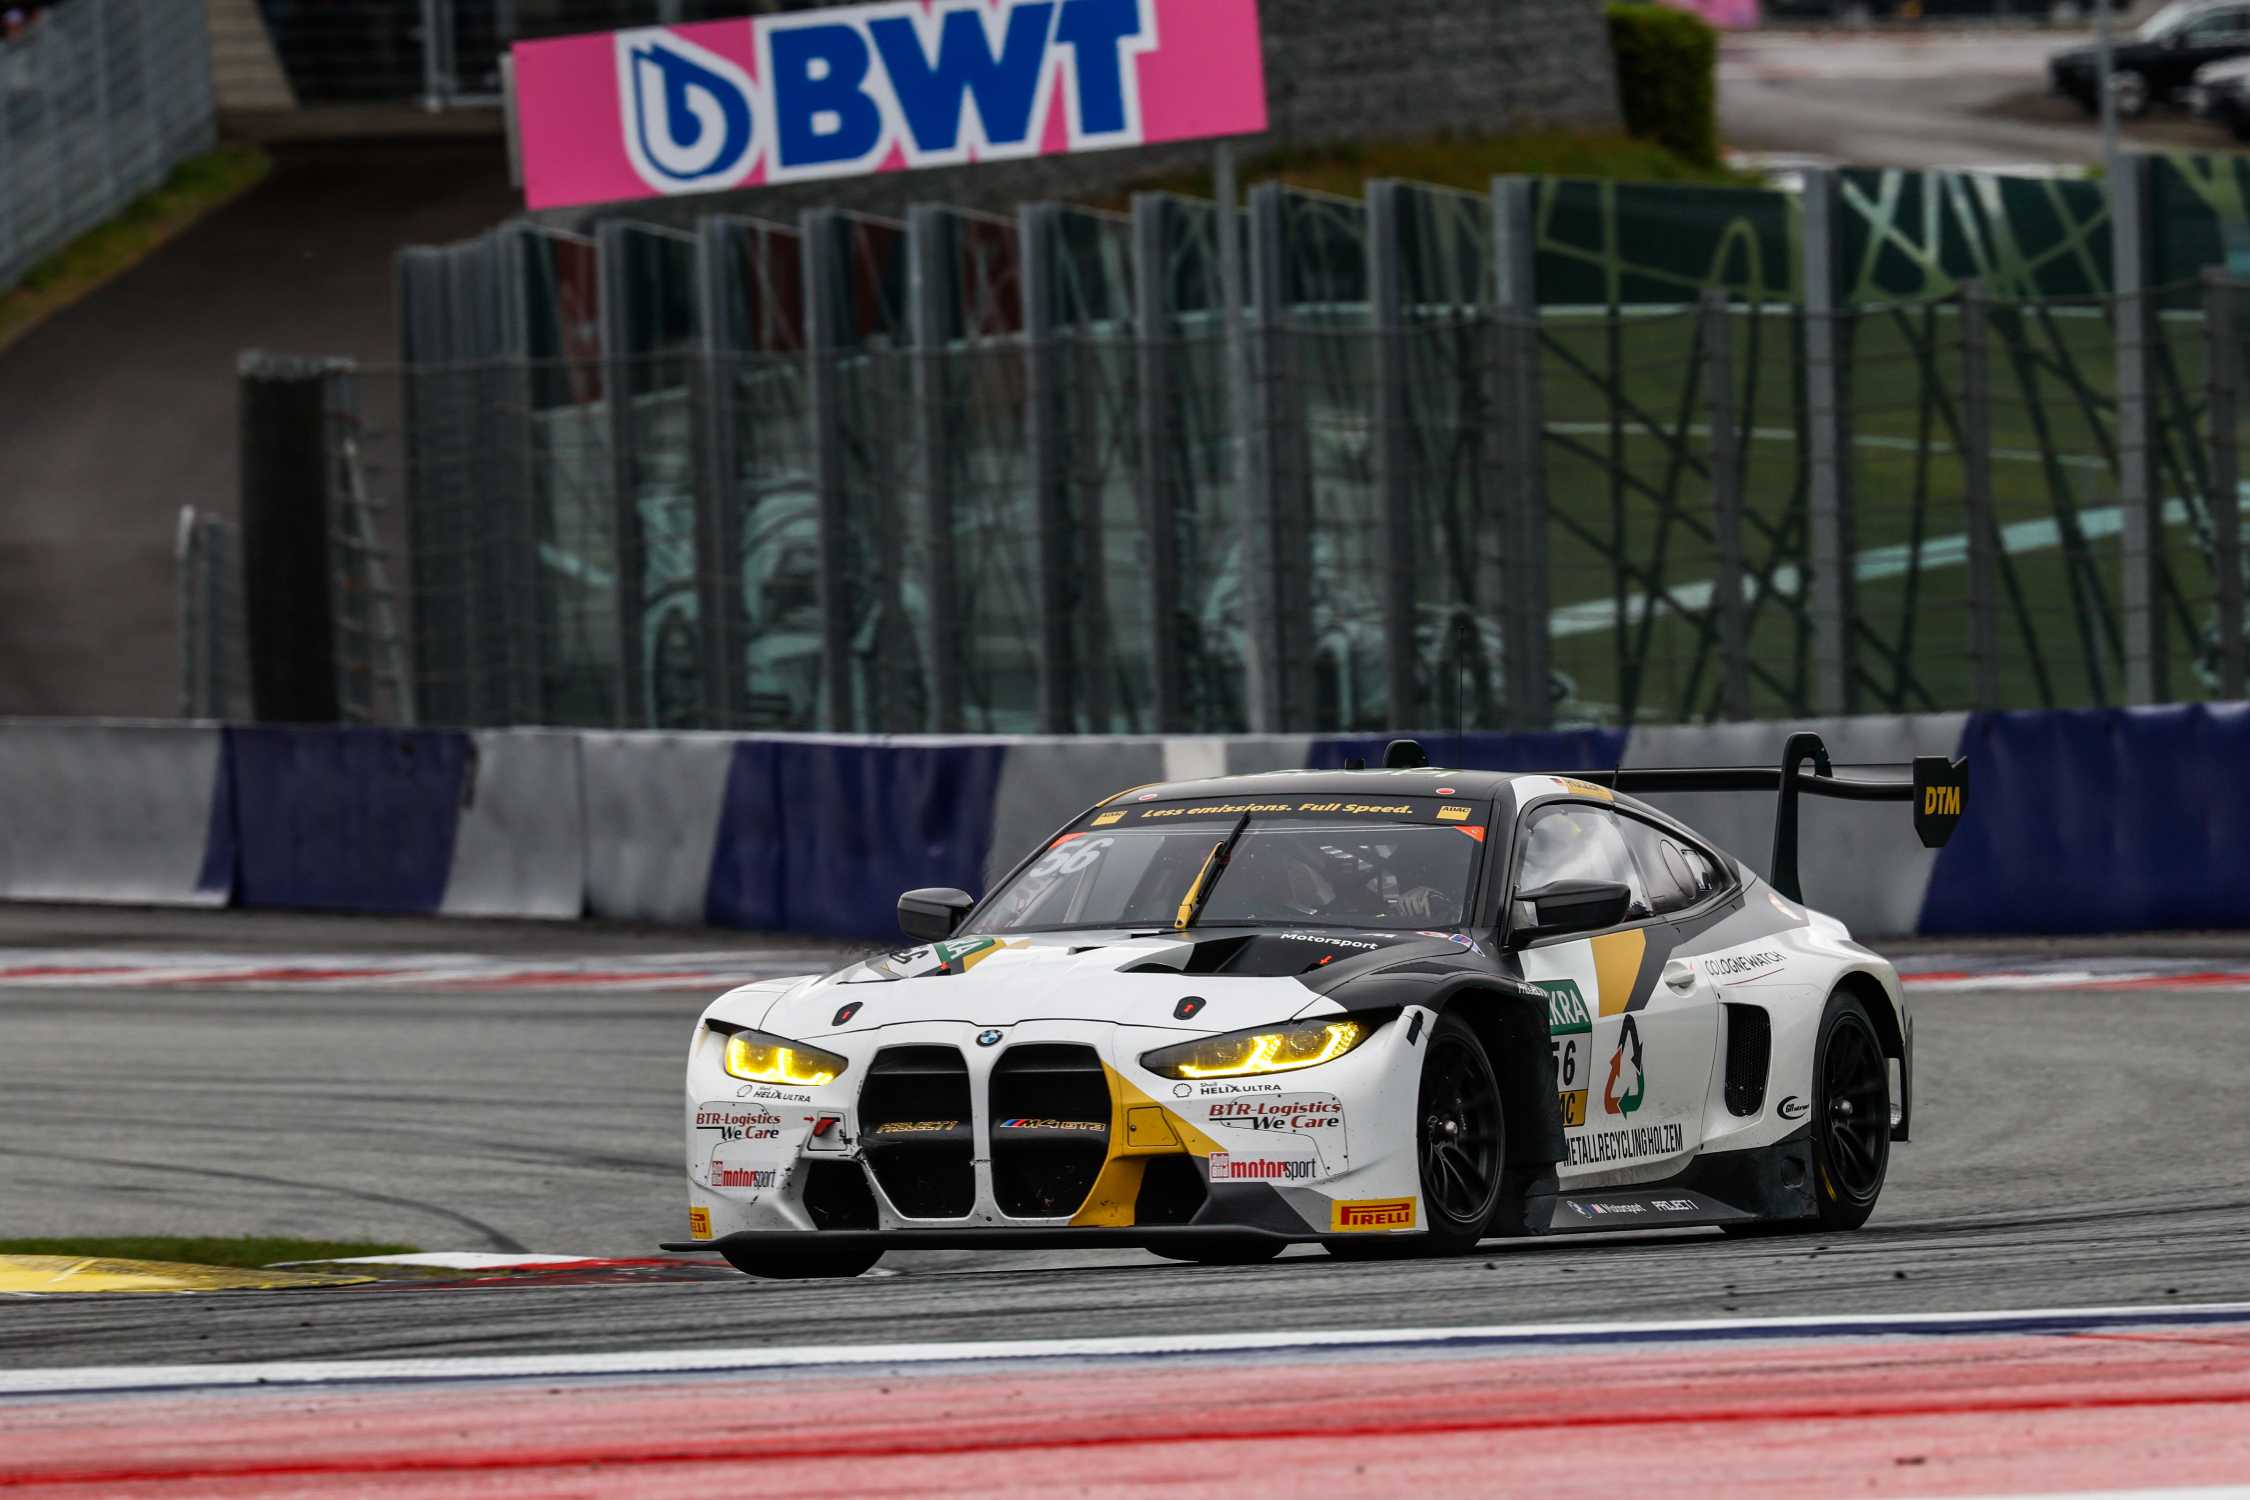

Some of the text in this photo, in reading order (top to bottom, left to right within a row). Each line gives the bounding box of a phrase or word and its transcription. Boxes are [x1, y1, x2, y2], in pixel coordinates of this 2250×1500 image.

[768, 0, 1141, 168] BWT
[1924, 786, 1960, 815] DTM
[1141, 803, 1413, 818] Less emissions. Full Speed.
[1030, 838, 1115, 877] 56
[1280, 932, 1379, 950] Motorsport
[1704, 950, 1787, 976] COLOGNEWATCH
[1549, 989, 1589, 1026] KRA
[753, 1090, 811, 1103] HELIX ULTRA
[1200, 1084, 1240, 1095] HELIX
[1208, 1101, 1341, 1116] BTR-Logistics
[696, 1112, 780, 1126] BTR-Logistics
[1253, 1115, 1339, 1130] We Care
[722, 1126, 779, 1140] We Care
[723, 1168, 775, 1189] motorsport
[1230, 1158, 1316, 1181] motorsport
[1341, 1203, 1410, 1225] PIRELLI
